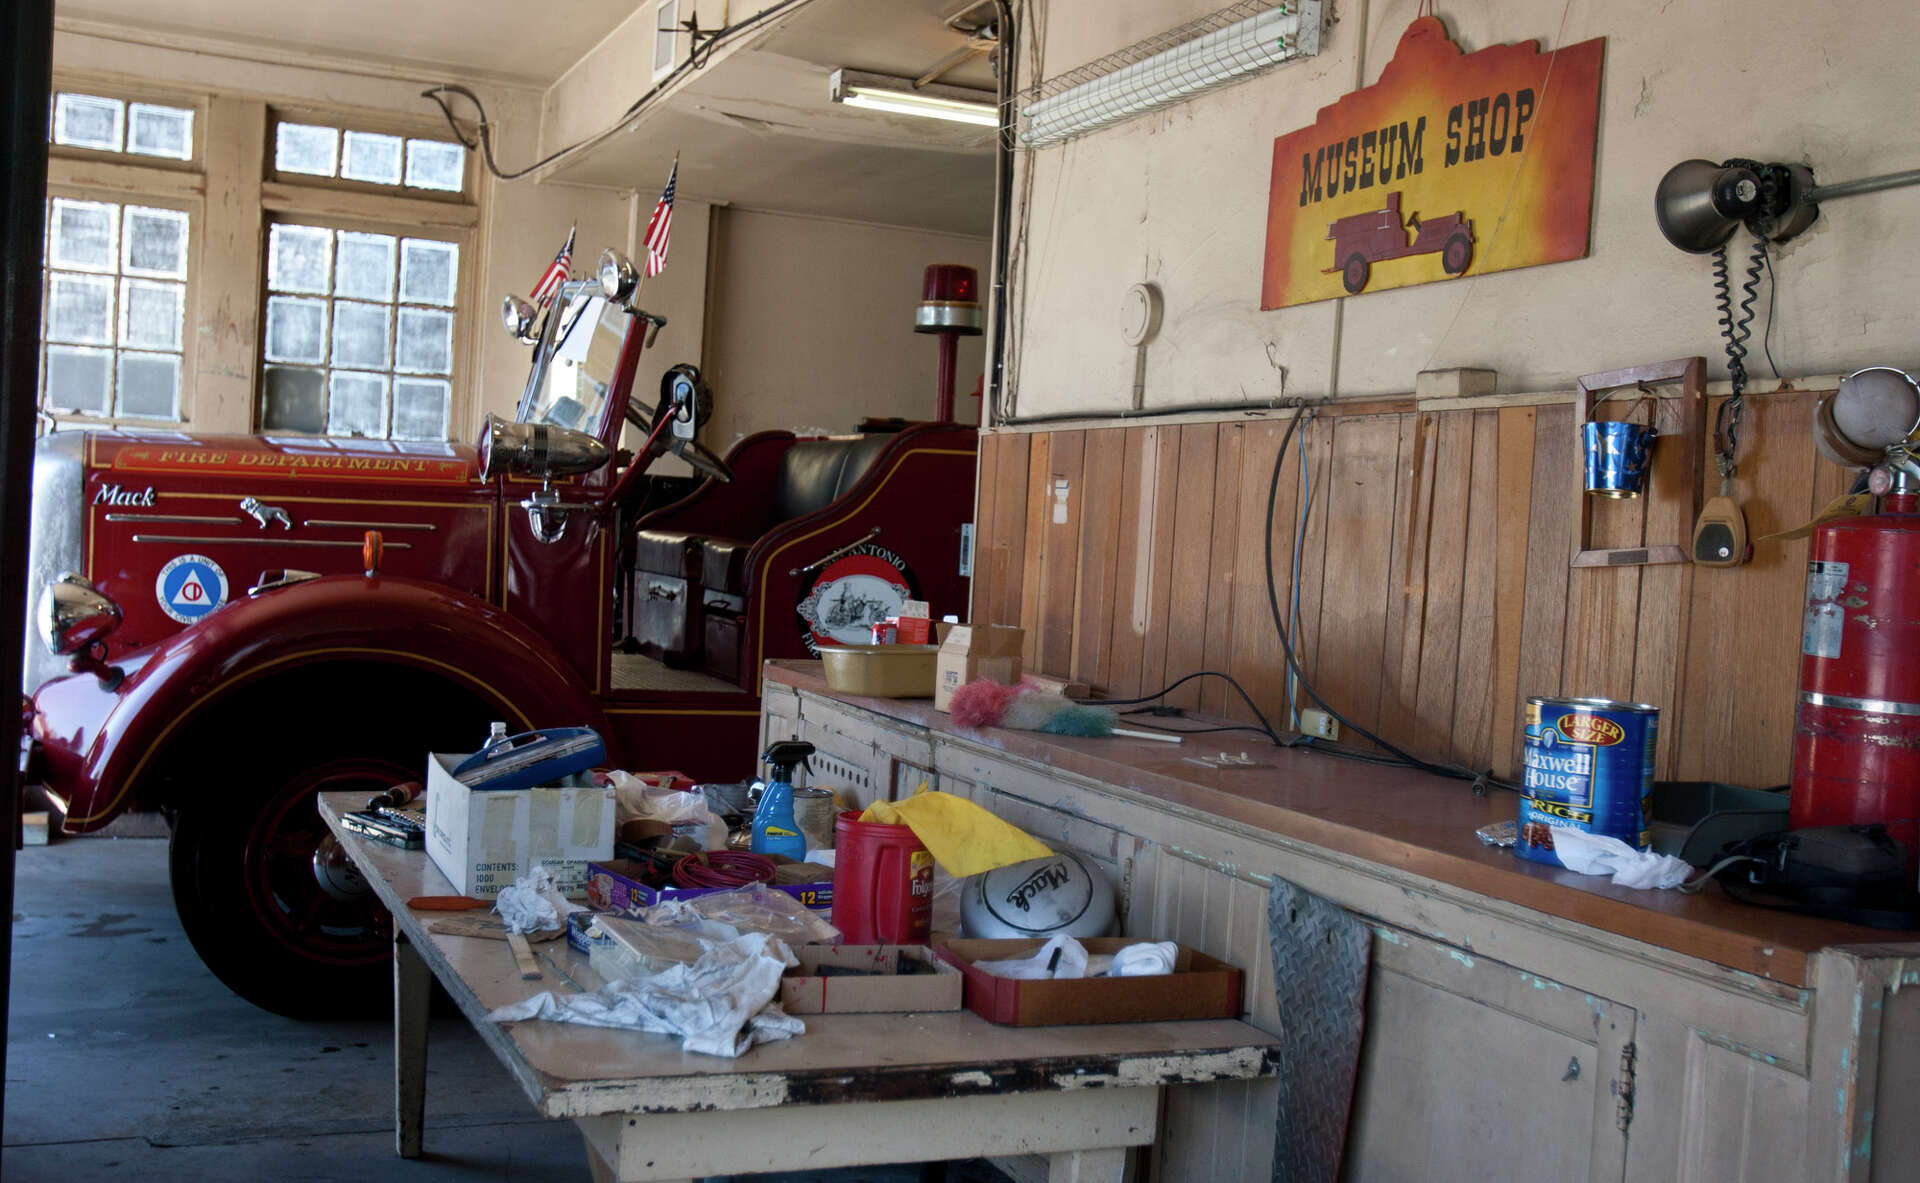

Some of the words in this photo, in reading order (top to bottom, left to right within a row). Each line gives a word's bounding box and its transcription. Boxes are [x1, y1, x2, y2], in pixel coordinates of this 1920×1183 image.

[1300, 116, 1426, 208] MUSEUM
[1445, 88, 1535, 168] SHOP
[158, 451, 227, 465] FIRE
[237, 454, 432, 473] DEPARTMENT
[93, 484, 156, 507] Mack
[1564, 716, 1619, 740] LARGER
[1572, 728, 1605, 743] SIZE
[1523, 746, 1591, 775] Maxwell
[1524, 767, 1579, 791] House
[1532, 799, 1591, 823] RICH
[475, 862, 520, 871] CONTENTS:
[800, 891, 816, 904] 12
[1006, 862, 1070, 913] Mack
